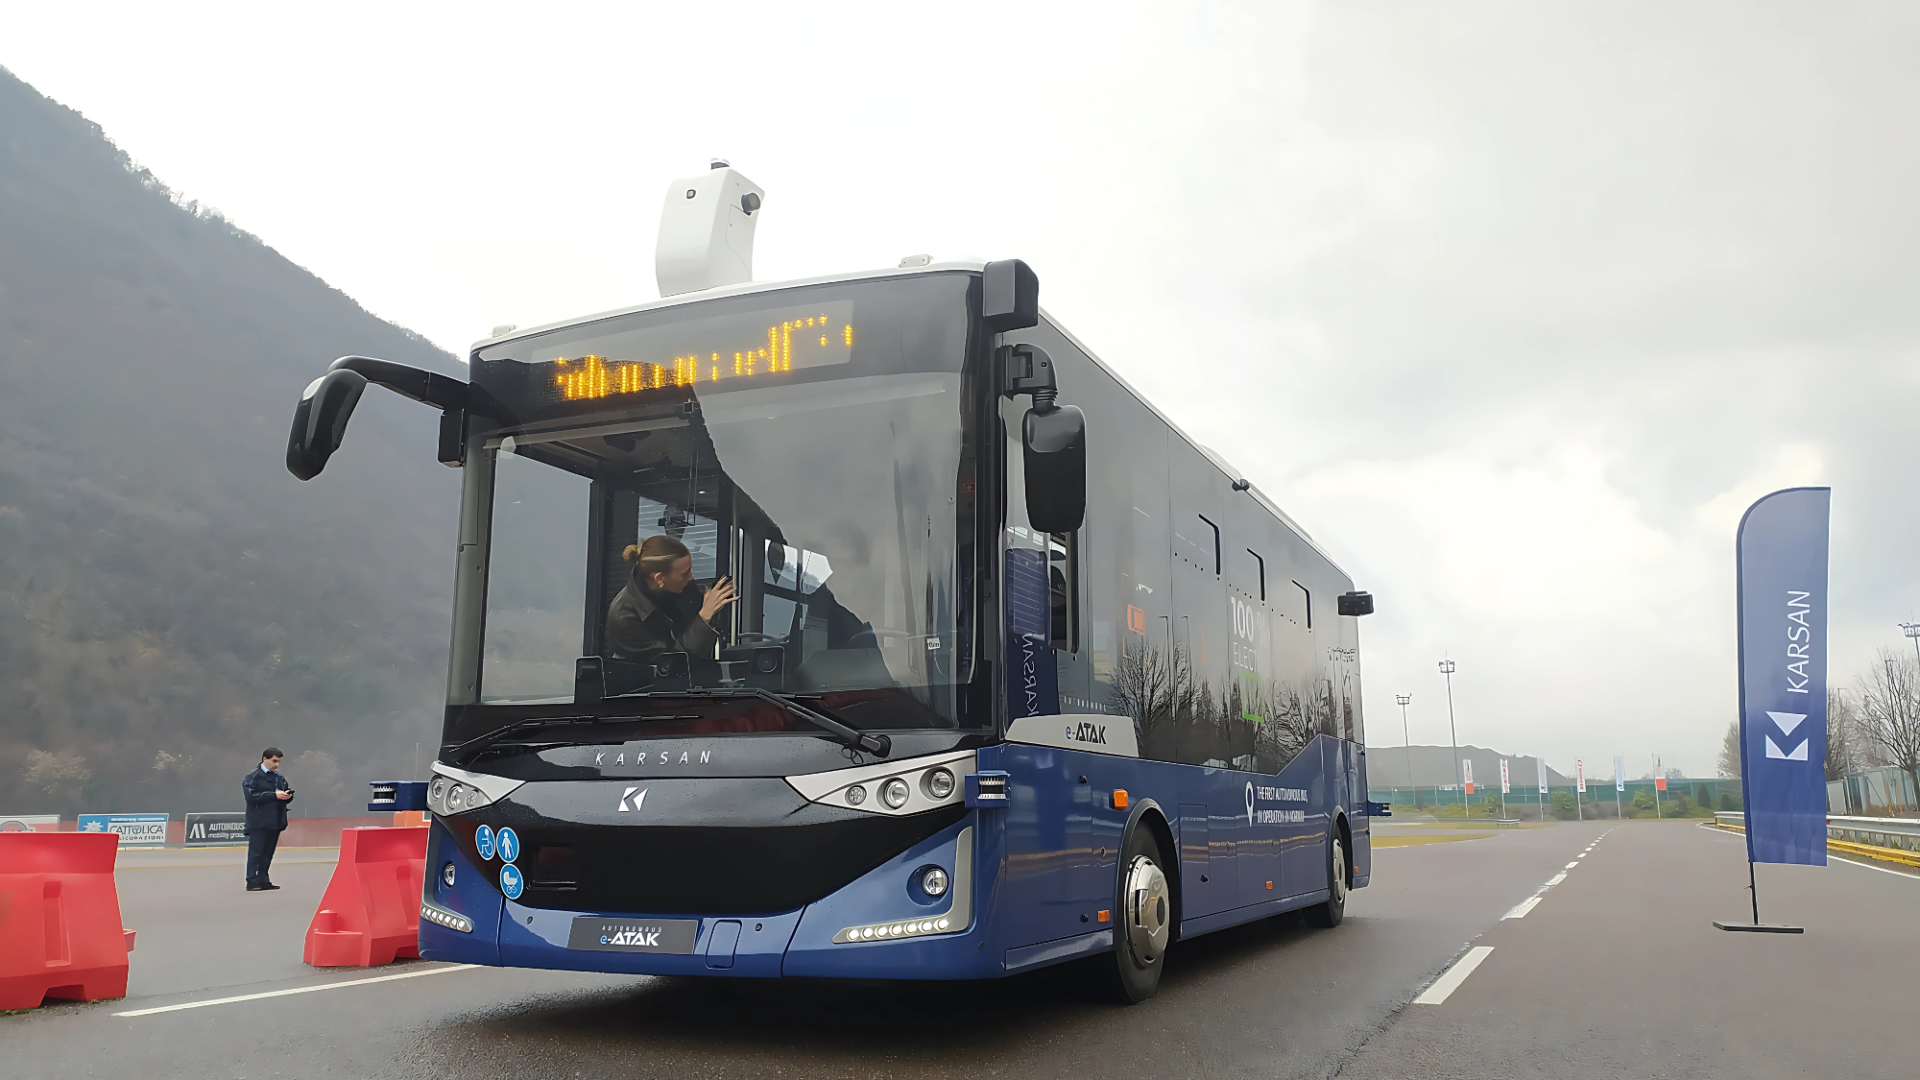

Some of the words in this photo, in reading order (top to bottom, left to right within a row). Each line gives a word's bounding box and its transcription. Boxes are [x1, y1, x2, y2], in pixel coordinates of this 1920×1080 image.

[1787, 590, 1811, 694] KARSAN
[1066, 721, 1107, 745] e-ATAK
[594, 750, 711, 766] KARSAN
[110, 825, 164, 834] CATTOLICA
[600, 931, 660, 947] e-ATAK
